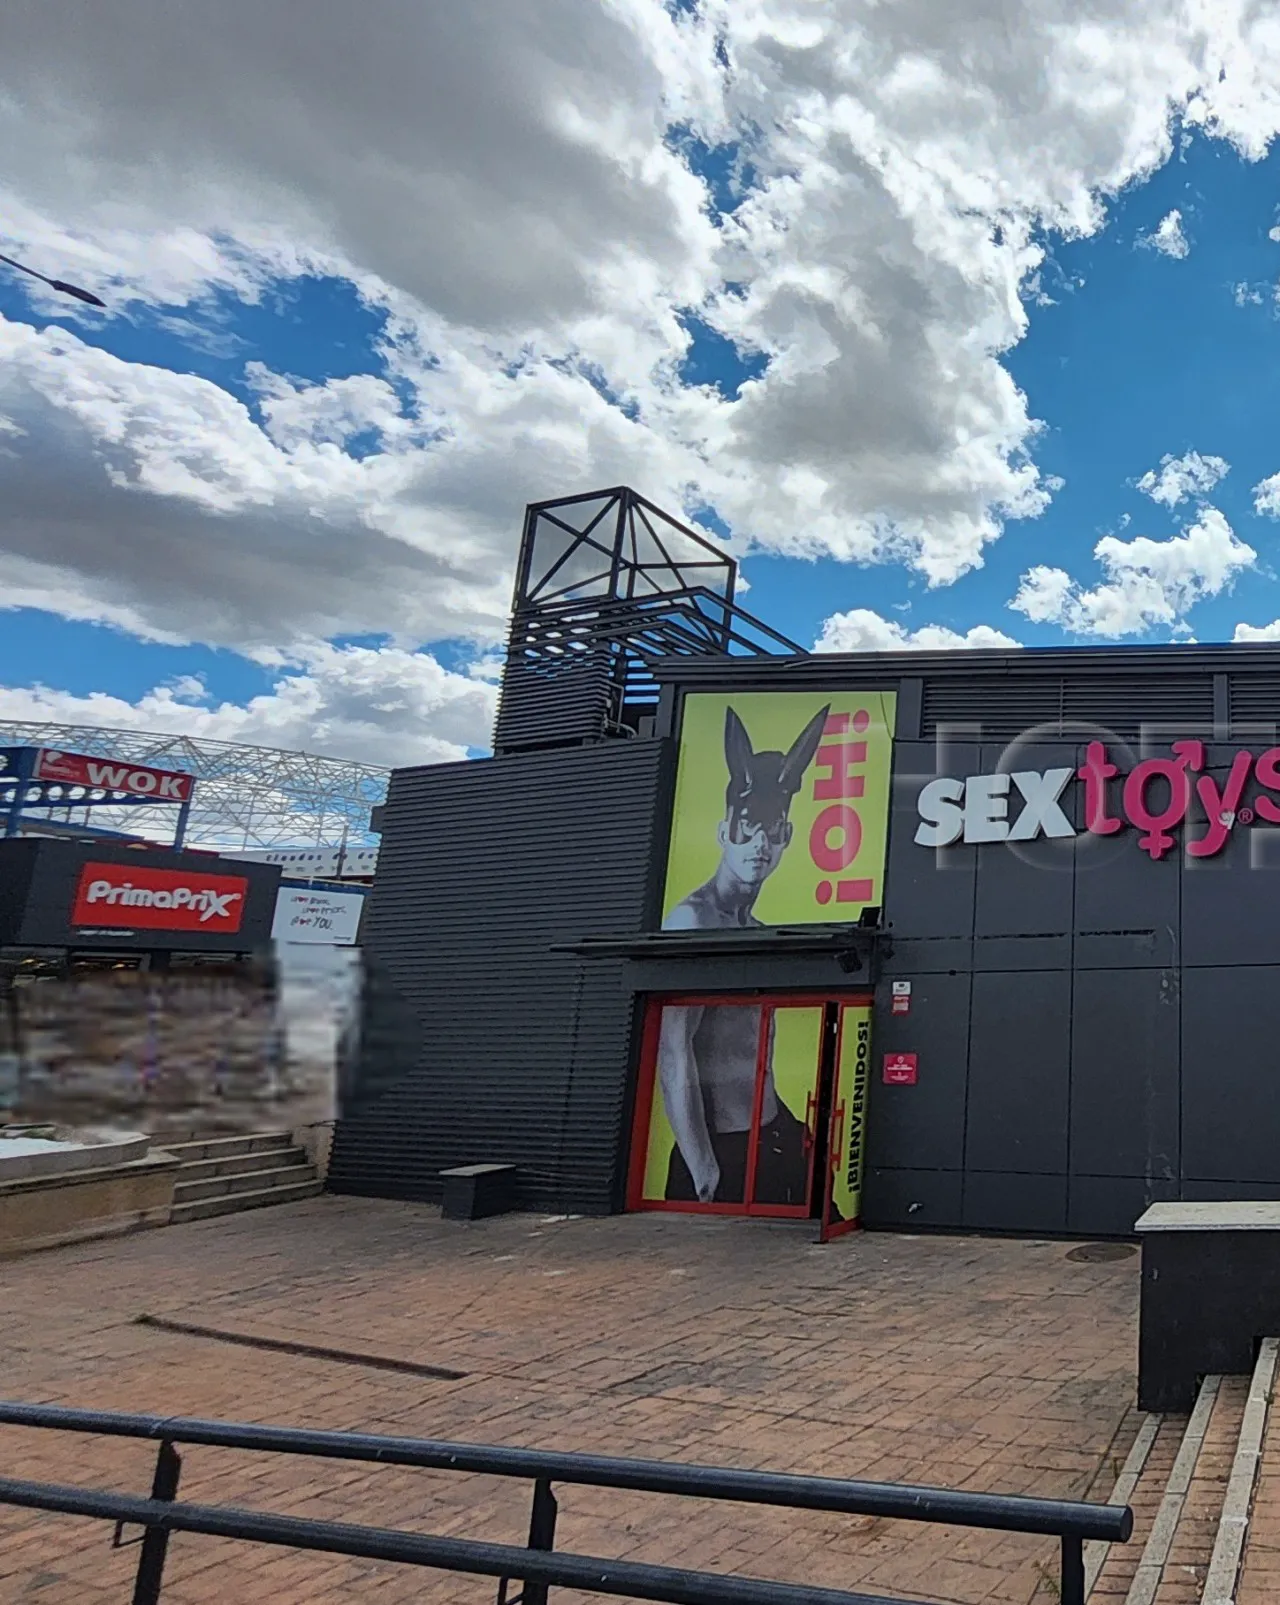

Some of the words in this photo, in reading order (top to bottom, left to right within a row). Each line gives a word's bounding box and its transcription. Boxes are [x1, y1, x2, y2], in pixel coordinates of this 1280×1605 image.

[86, 762, 184, 797] WOK
[914, 767, 1078, 848] SEX
[847, 1020, 870, 1193] ¡BIENVENIDOS!
